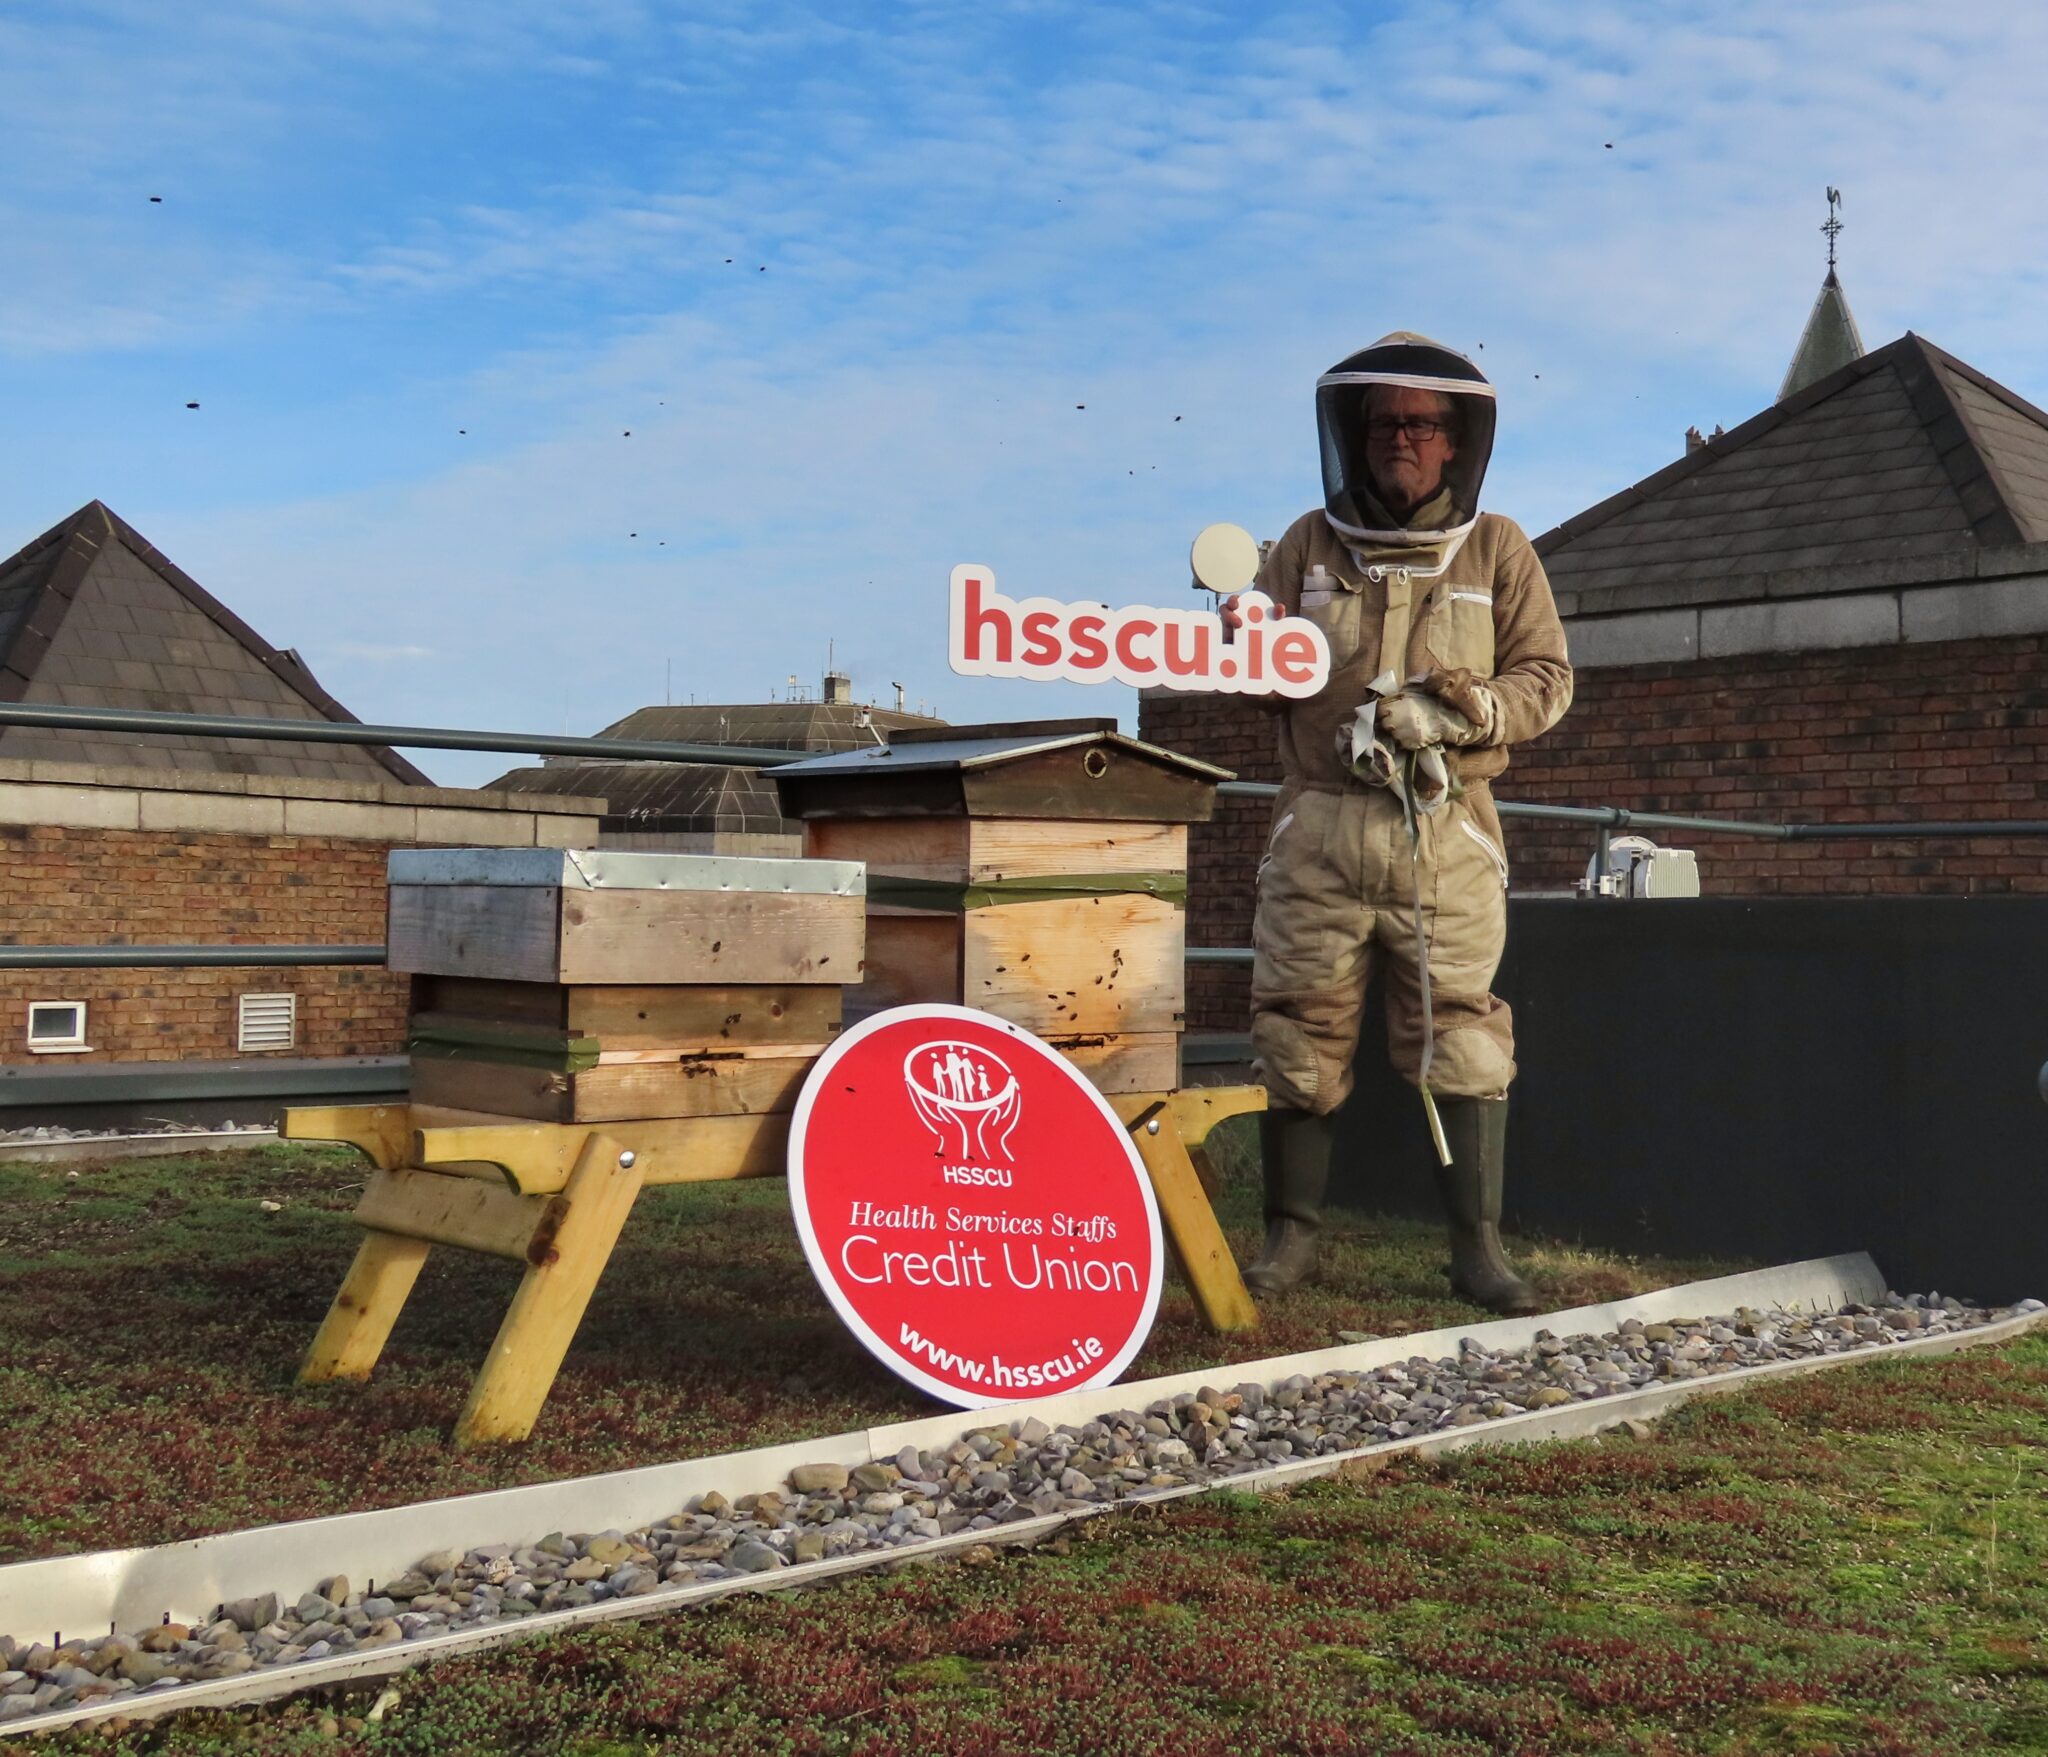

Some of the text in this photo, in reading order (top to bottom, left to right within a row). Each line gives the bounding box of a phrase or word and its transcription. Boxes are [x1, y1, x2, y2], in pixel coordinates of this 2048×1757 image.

[964, 579, 1318, 684] hsscu.ie
[943, 1165, 1013, 1187] HSSCU
[849, 1201, 1117, 1243] Health Services Staffs
[841, 1234, 1139, 1292] Credit Union
[899, 1322, 1104, 1388] www.hsscu.ie
